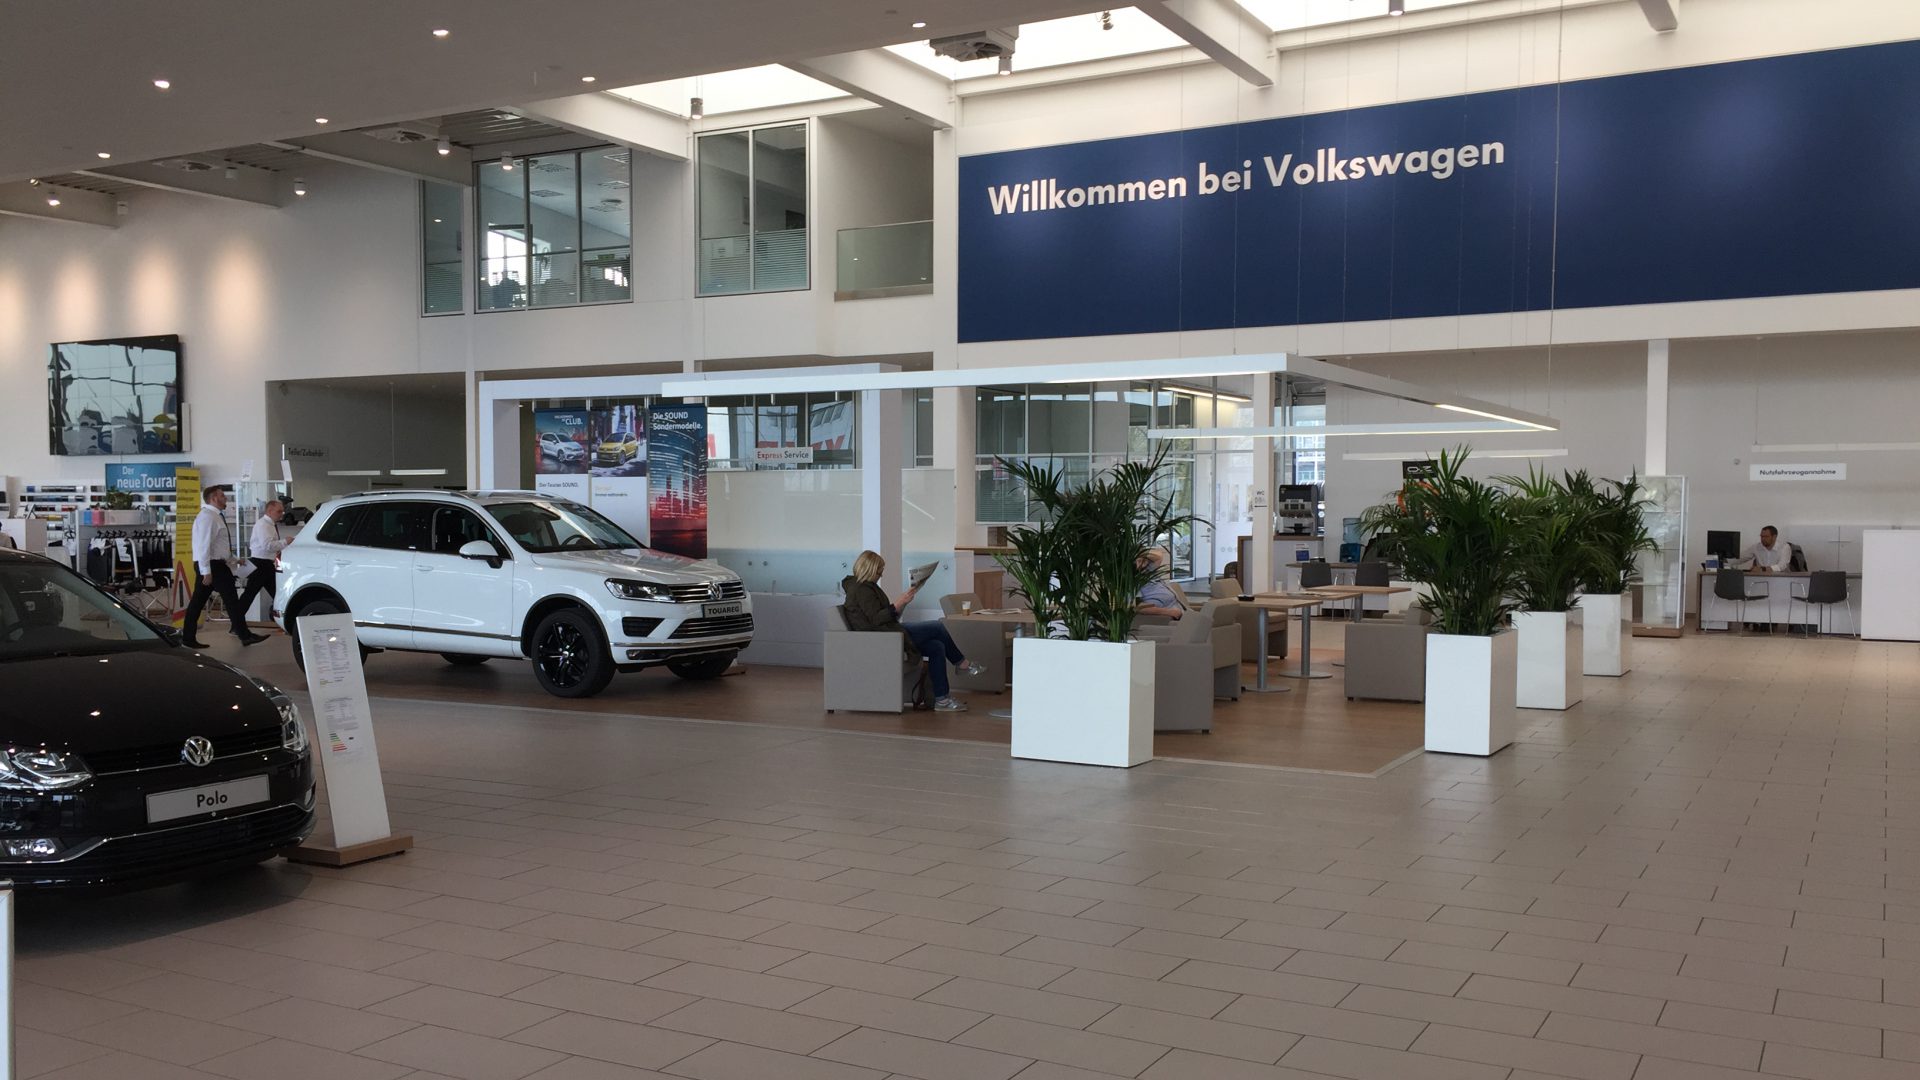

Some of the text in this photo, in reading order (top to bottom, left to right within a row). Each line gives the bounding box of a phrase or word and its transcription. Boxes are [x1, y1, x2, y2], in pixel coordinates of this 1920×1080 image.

[988, 142, 1505, 215] Willkommen bei Volkswagen
[653, 411, 689, 420] Die SOUND
[653, 422, 703, 430] Sondermodelle.
[757, 451, 809, 460] Express Service
[122, 466, 135, 475] Der
[117, 478, 141, 489] neue
[707, 606, 740, 615] TOUAREG
[196, 790, 228, 808] Polo
